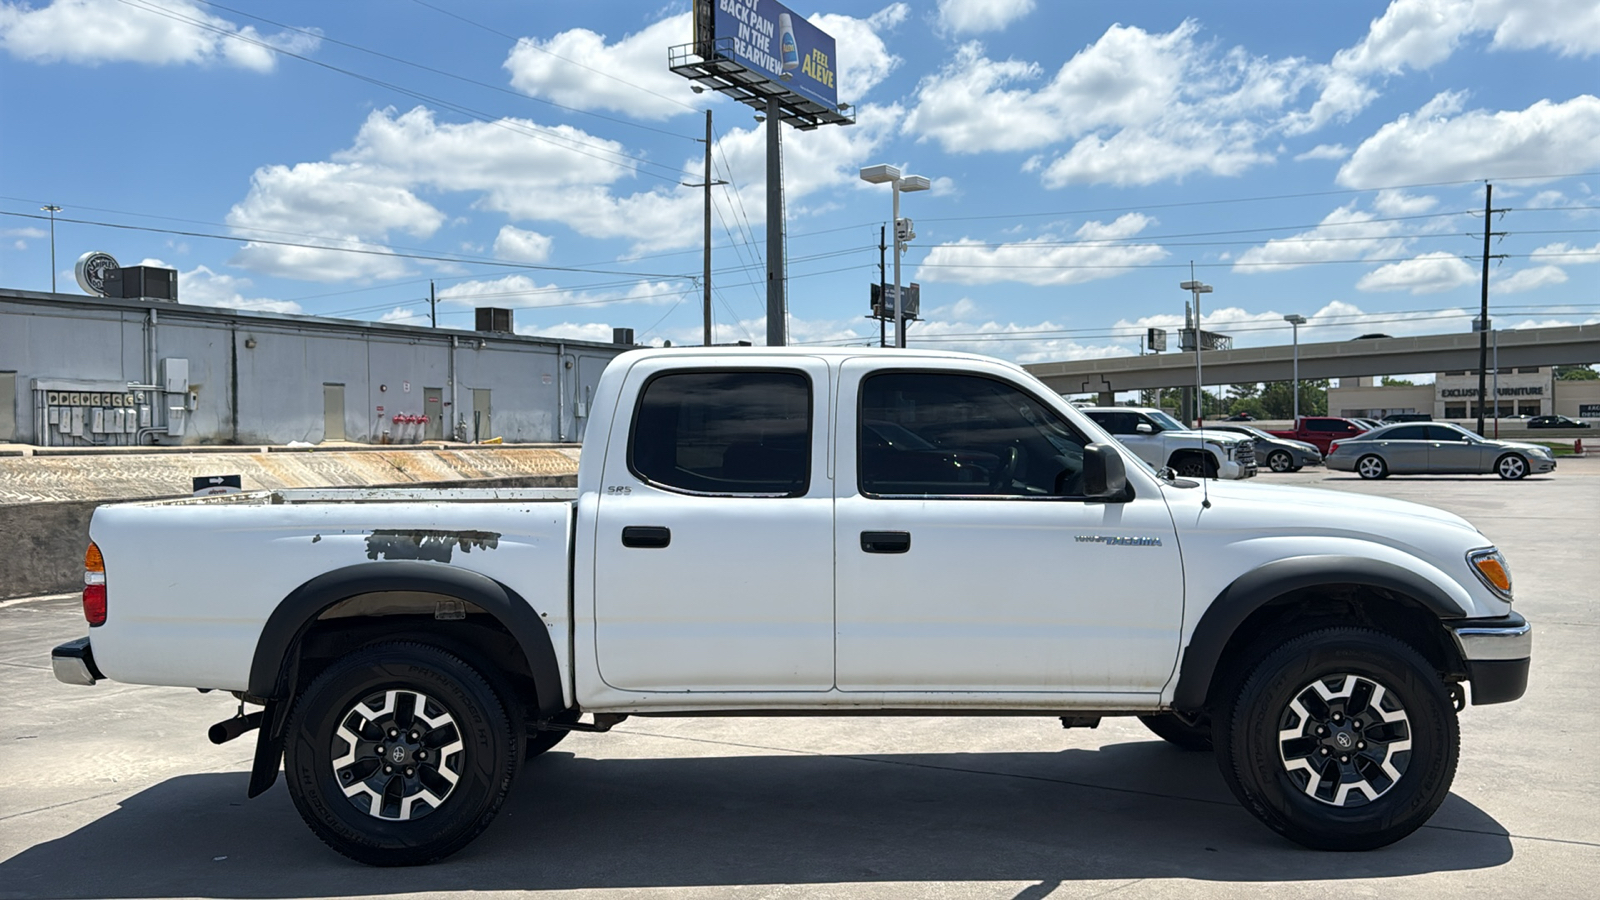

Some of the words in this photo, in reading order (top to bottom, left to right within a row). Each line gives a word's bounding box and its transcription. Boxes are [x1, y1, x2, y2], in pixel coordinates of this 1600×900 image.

[720, 0, 749, 25] BACK
[749, 11, 774, 39] PAIN
[738, 0, 759, 12] UT
[738, 22, 751, 42] IN
[751, 29, 770, 53] THE
[733, 37, 783, 76] REARVIEW
[802, 54, 834, 89] ALEVE
[812, 48, 828, 68] FEEL
[1106, 537, 1162, 547] TACOMA
